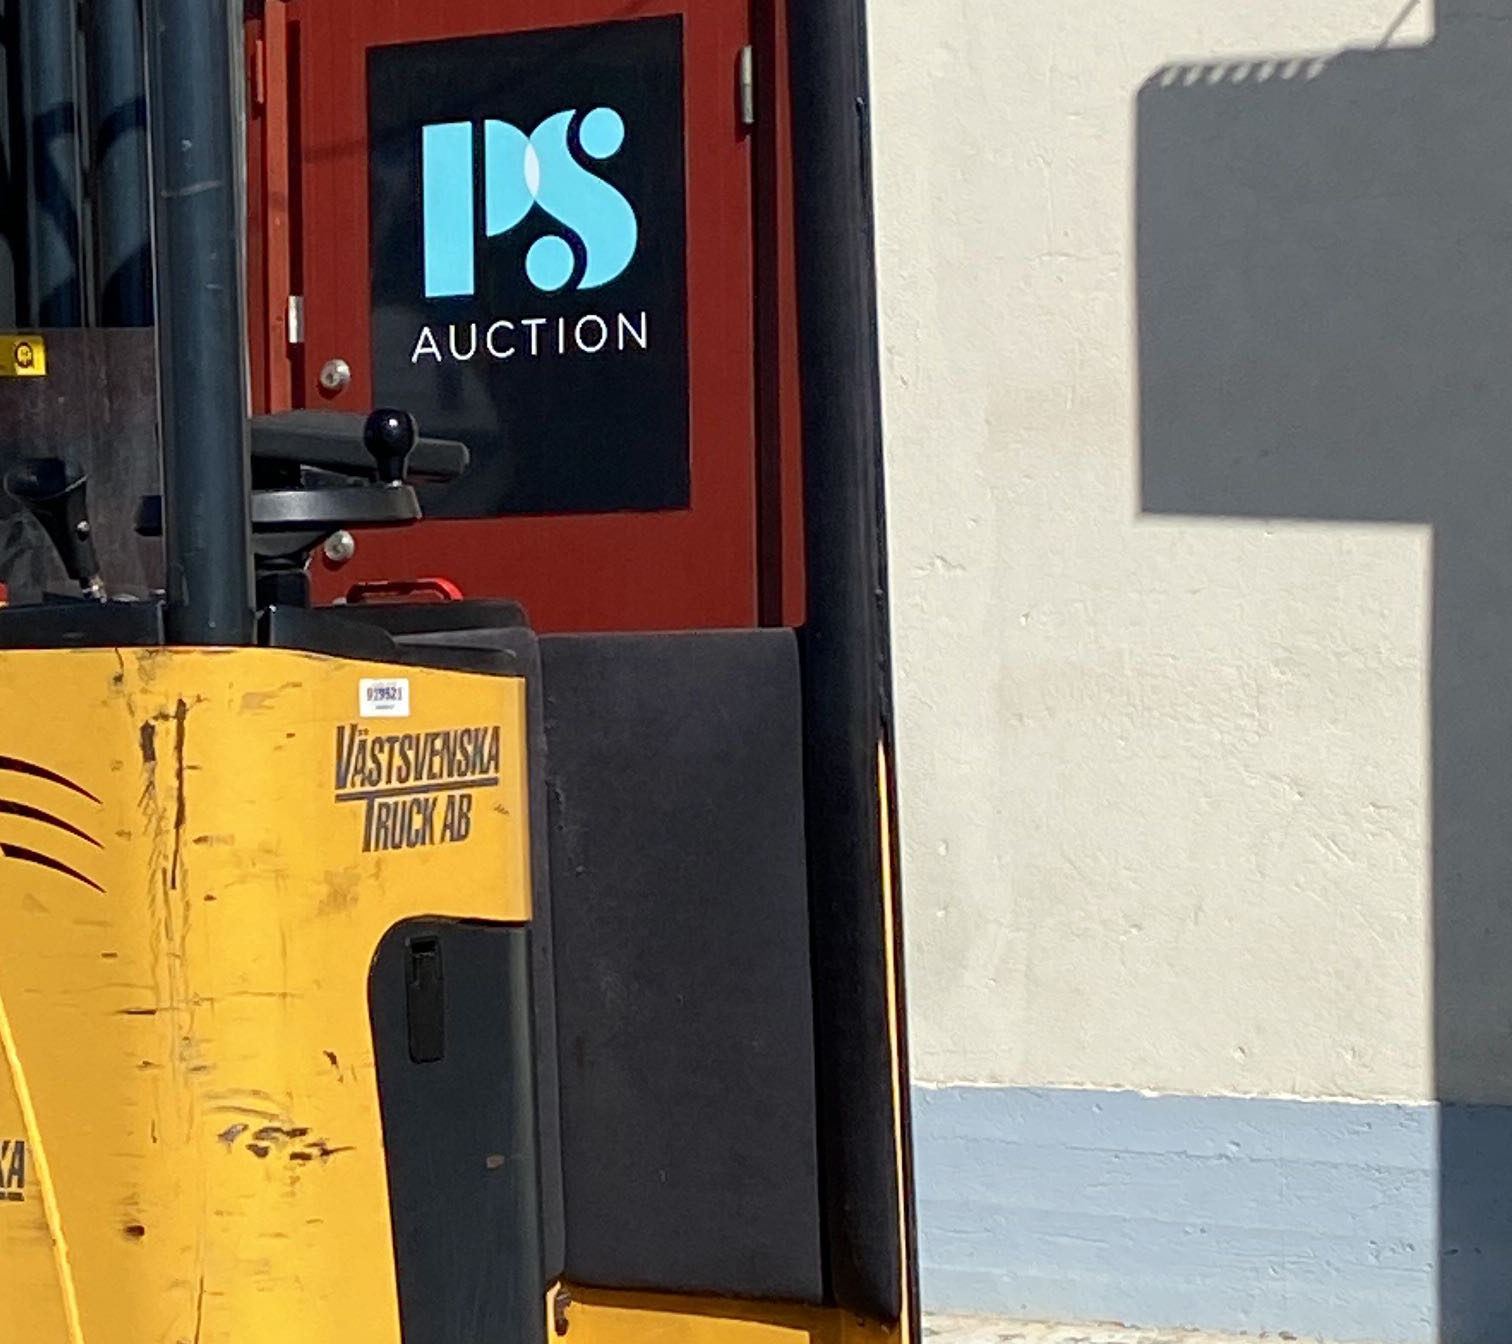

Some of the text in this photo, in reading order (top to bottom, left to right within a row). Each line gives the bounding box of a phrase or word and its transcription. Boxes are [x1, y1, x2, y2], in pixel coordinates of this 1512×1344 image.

[421, 106, 639, 298] PS
[411, 311, 649, 364] AUCTION
[334, 722, 501, 791] VÄSTSVENSKA
[361, 793, 473, 853] TRUCK AB
